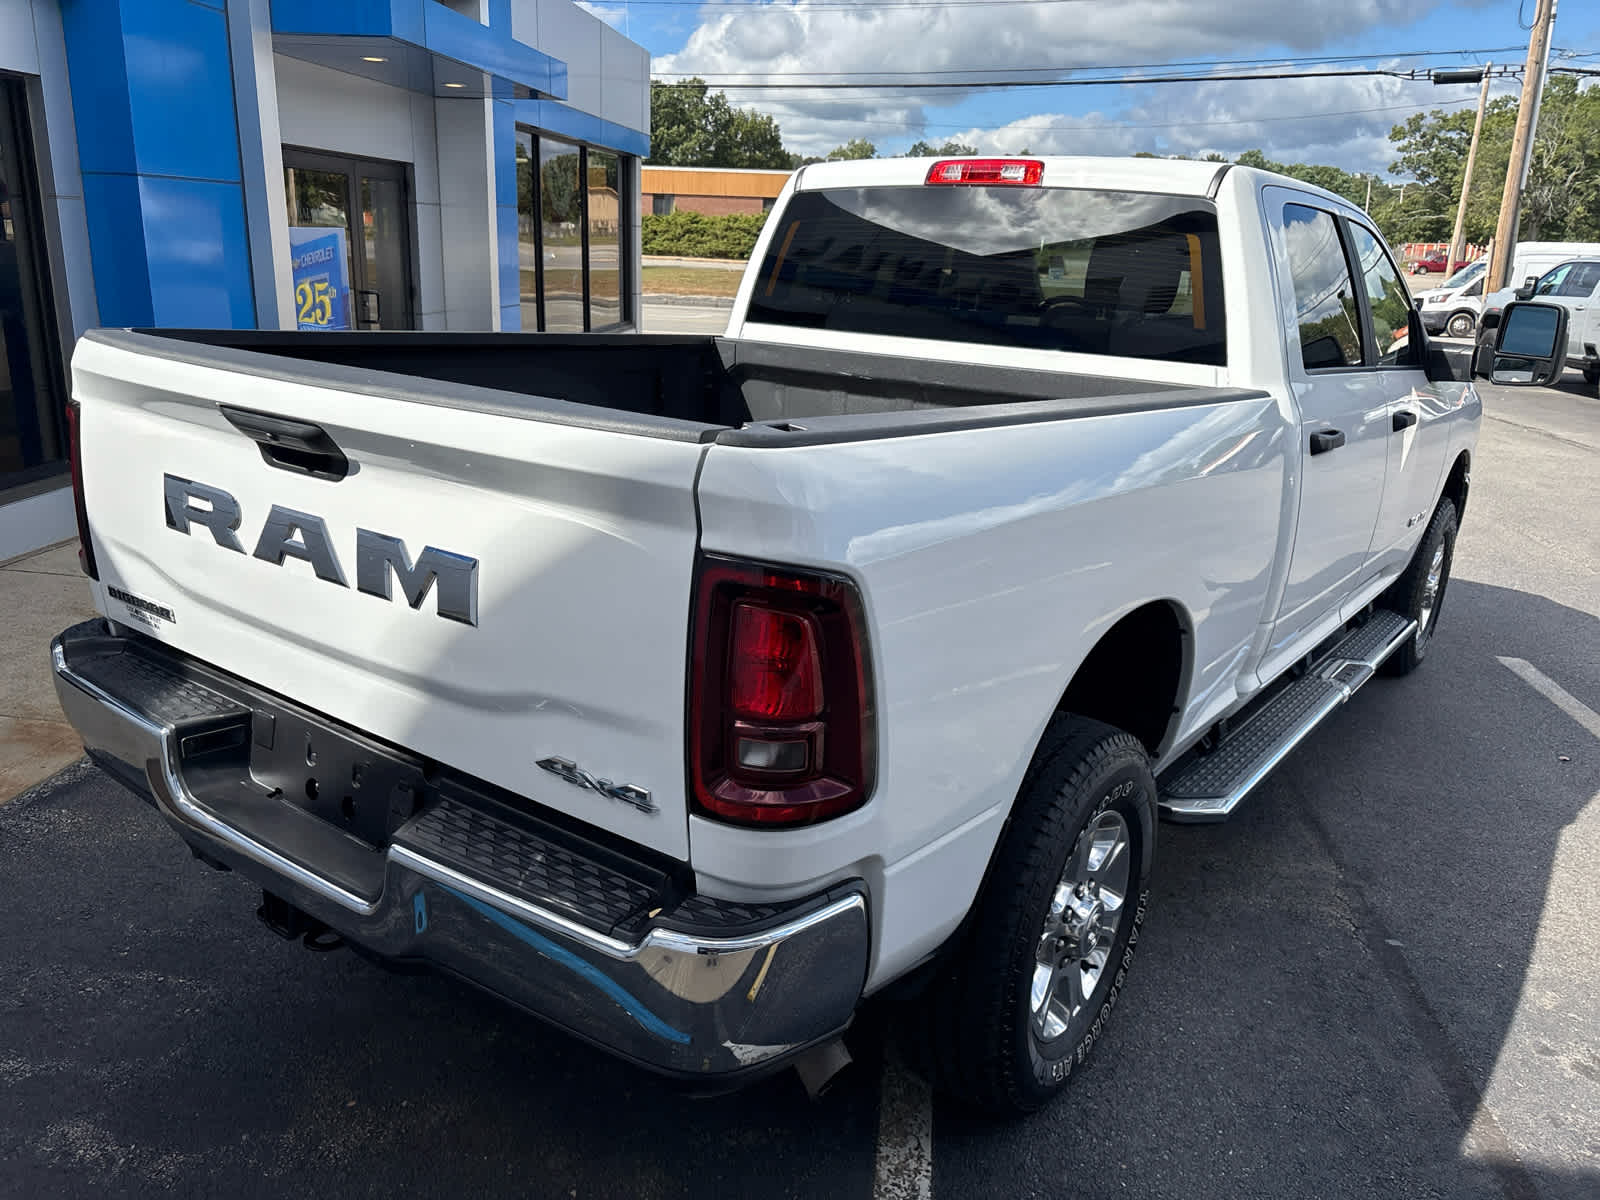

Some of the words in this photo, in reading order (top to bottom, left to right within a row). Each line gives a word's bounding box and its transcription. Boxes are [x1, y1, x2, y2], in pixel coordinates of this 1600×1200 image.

[300, 247, 334, 268] CHEVROLET
[163, 472, 479, 628] RAM
[1077, 889, 1149, 1064] TRANSFORCE
